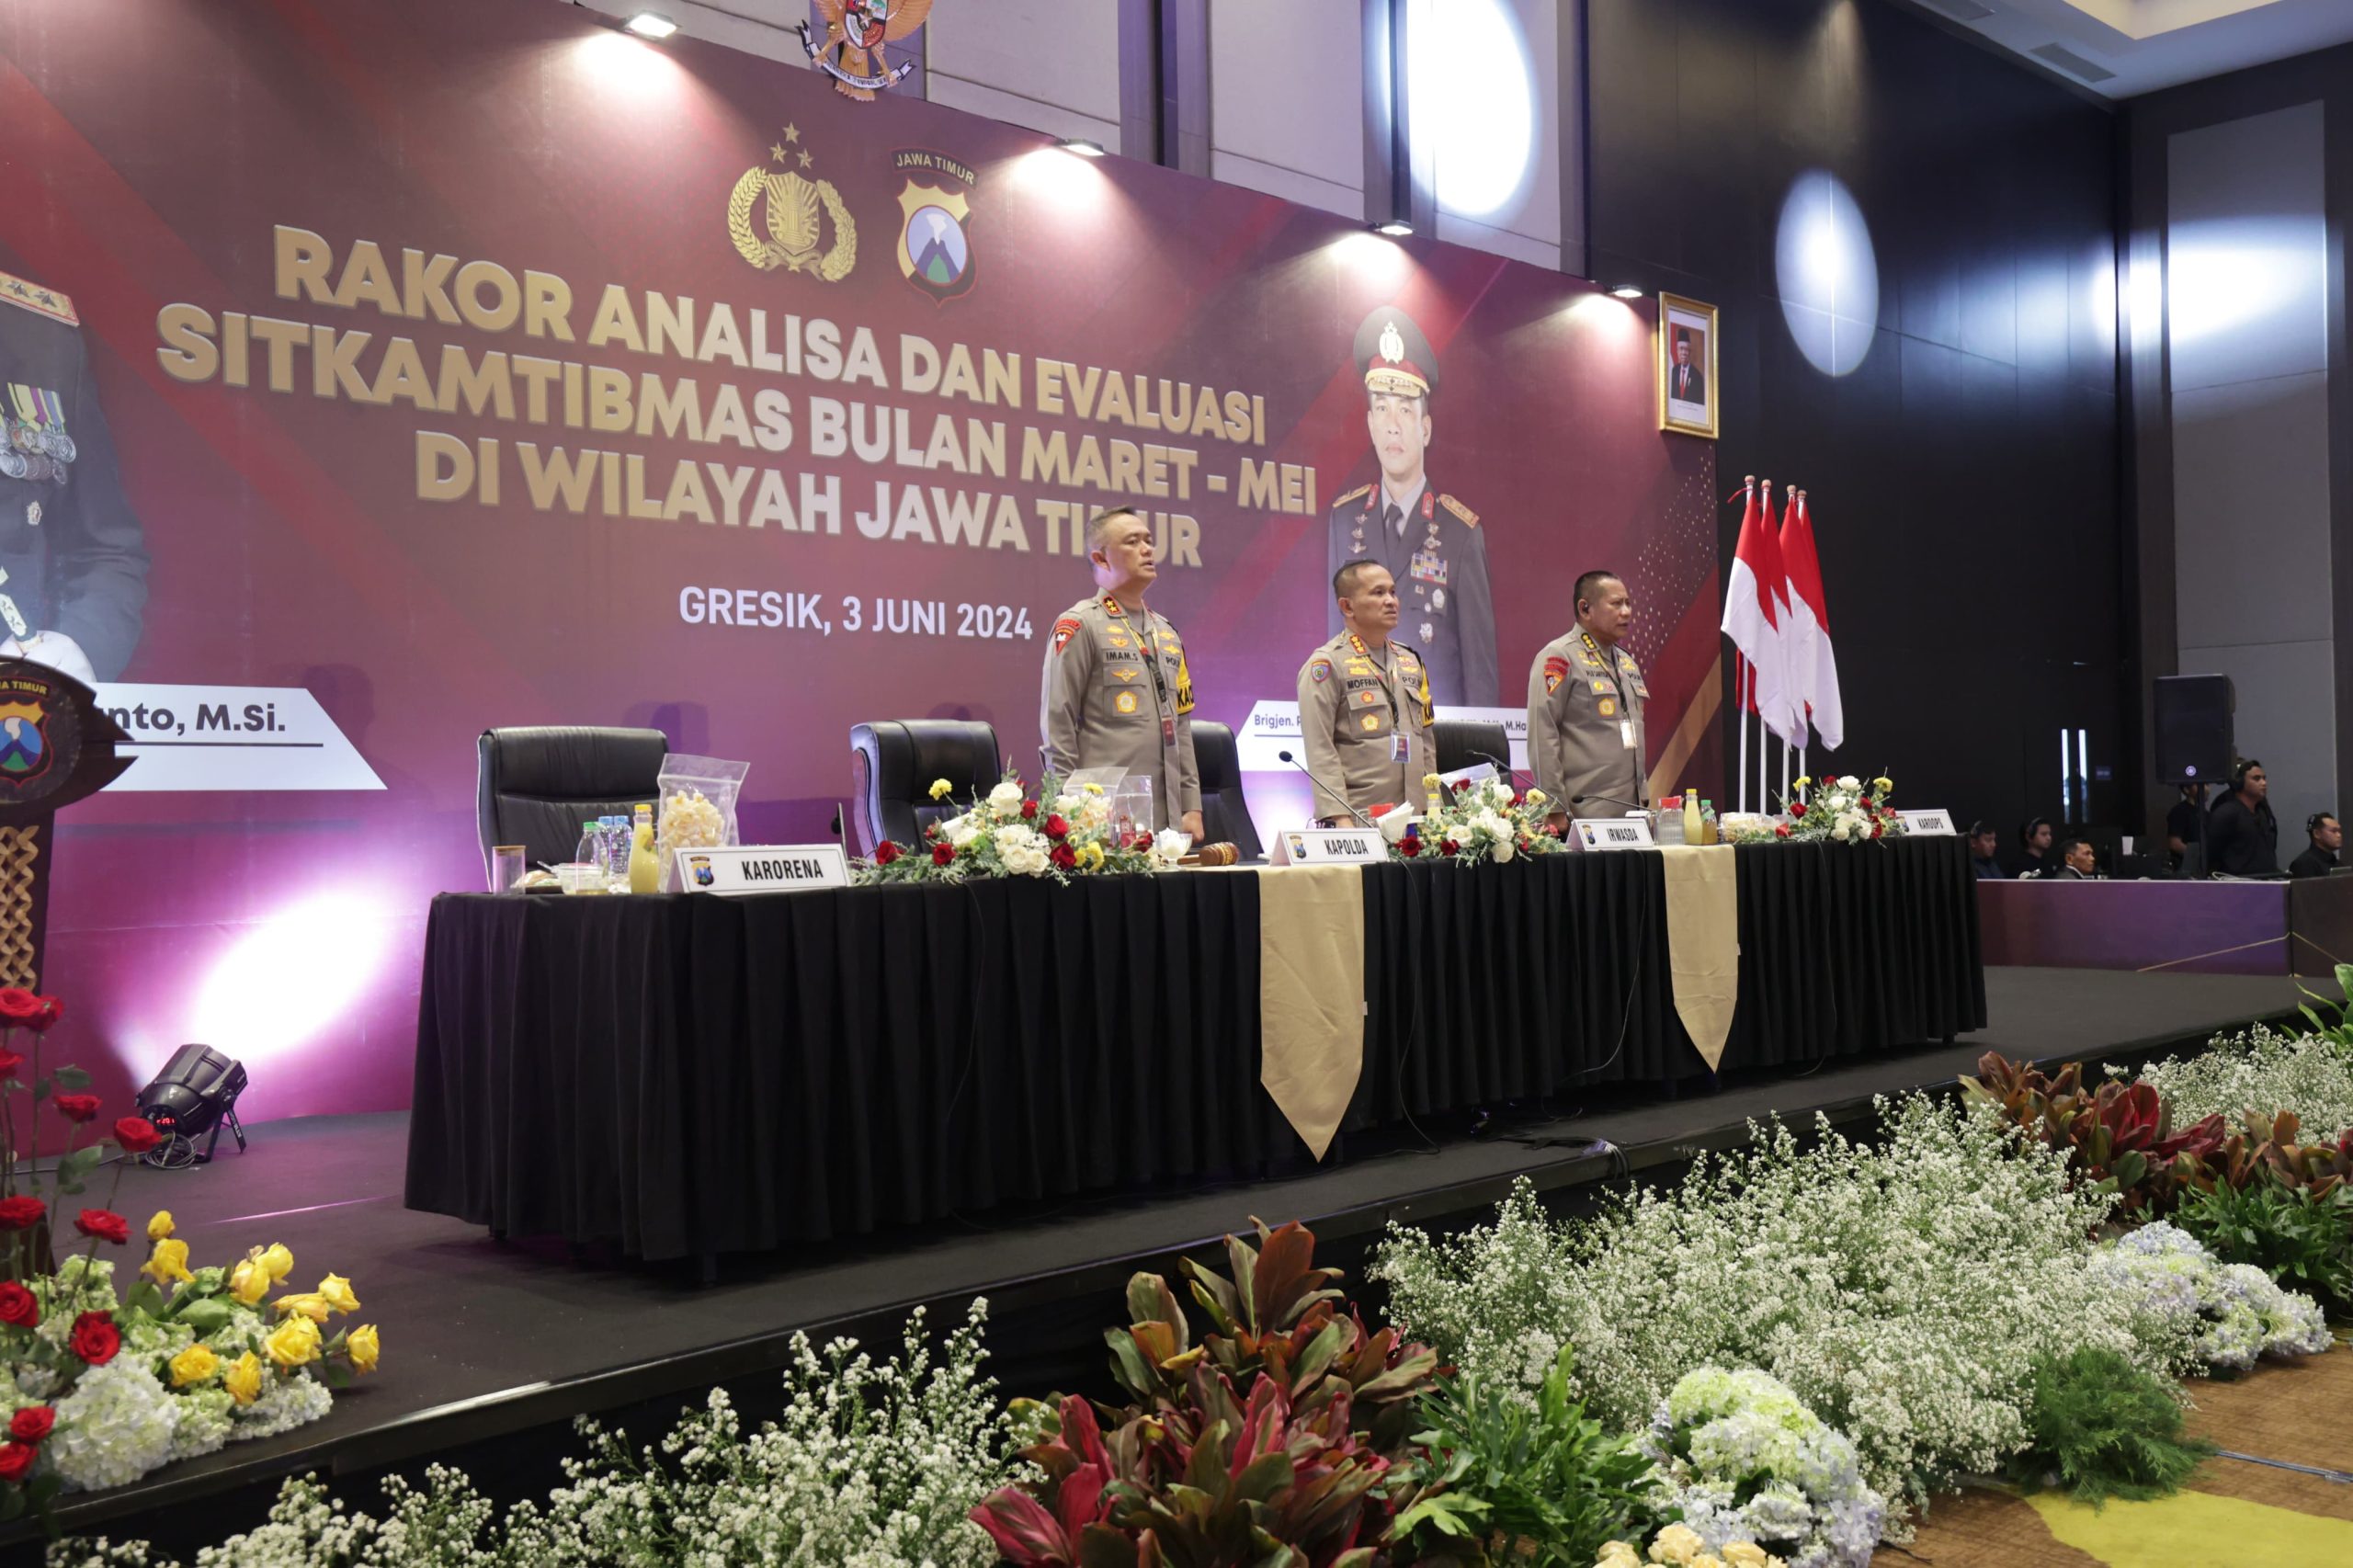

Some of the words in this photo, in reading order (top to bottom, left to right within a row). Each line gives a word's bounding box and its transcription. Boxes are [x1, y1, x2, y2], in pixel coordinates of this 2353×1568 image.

[896, 153, 932, 167] JAWA
[935, 155, 975, 186] TIMUR
[275, 224, 575, 343] RAKOR
[588, 283, 888, 388] ANALISA
[901, 333, 1021, 409] DAN
[1036, 357, 1266, 447] EVALUASI
[156, 303, 792, 452] SITKAMTIBMAS
[809, 395, 1007, 478] BULAN
[1020, 426, 1199, 500] MARET
[1207, 472, 1227, 494] -
[1237, 456, 1317, 517] MEI
[416, 430, 501, 506] DI
[516, 441, 841, 536] WILAYAH
[855, 475, 1030, 552] JAWA
[1036, 498, 1203, 568] TIUR
[679, 585, 831, 637] GRESIK,
[842, 596, 862, 631] 3
[872, 598, 946, 635] JUNI
[956, 603, 1032, 640] 2024
[11, 680, 48, 696] TIMUR
[196, 703, 286, 732] M.Si.
[1254, 713, 1294, 729] Brigjen.
[1324, 838, 1370, 856] KAPOLDA
[1606, 828, 1640, 842] IRWASDA
[741, 858, 824, 881] KARORENA
